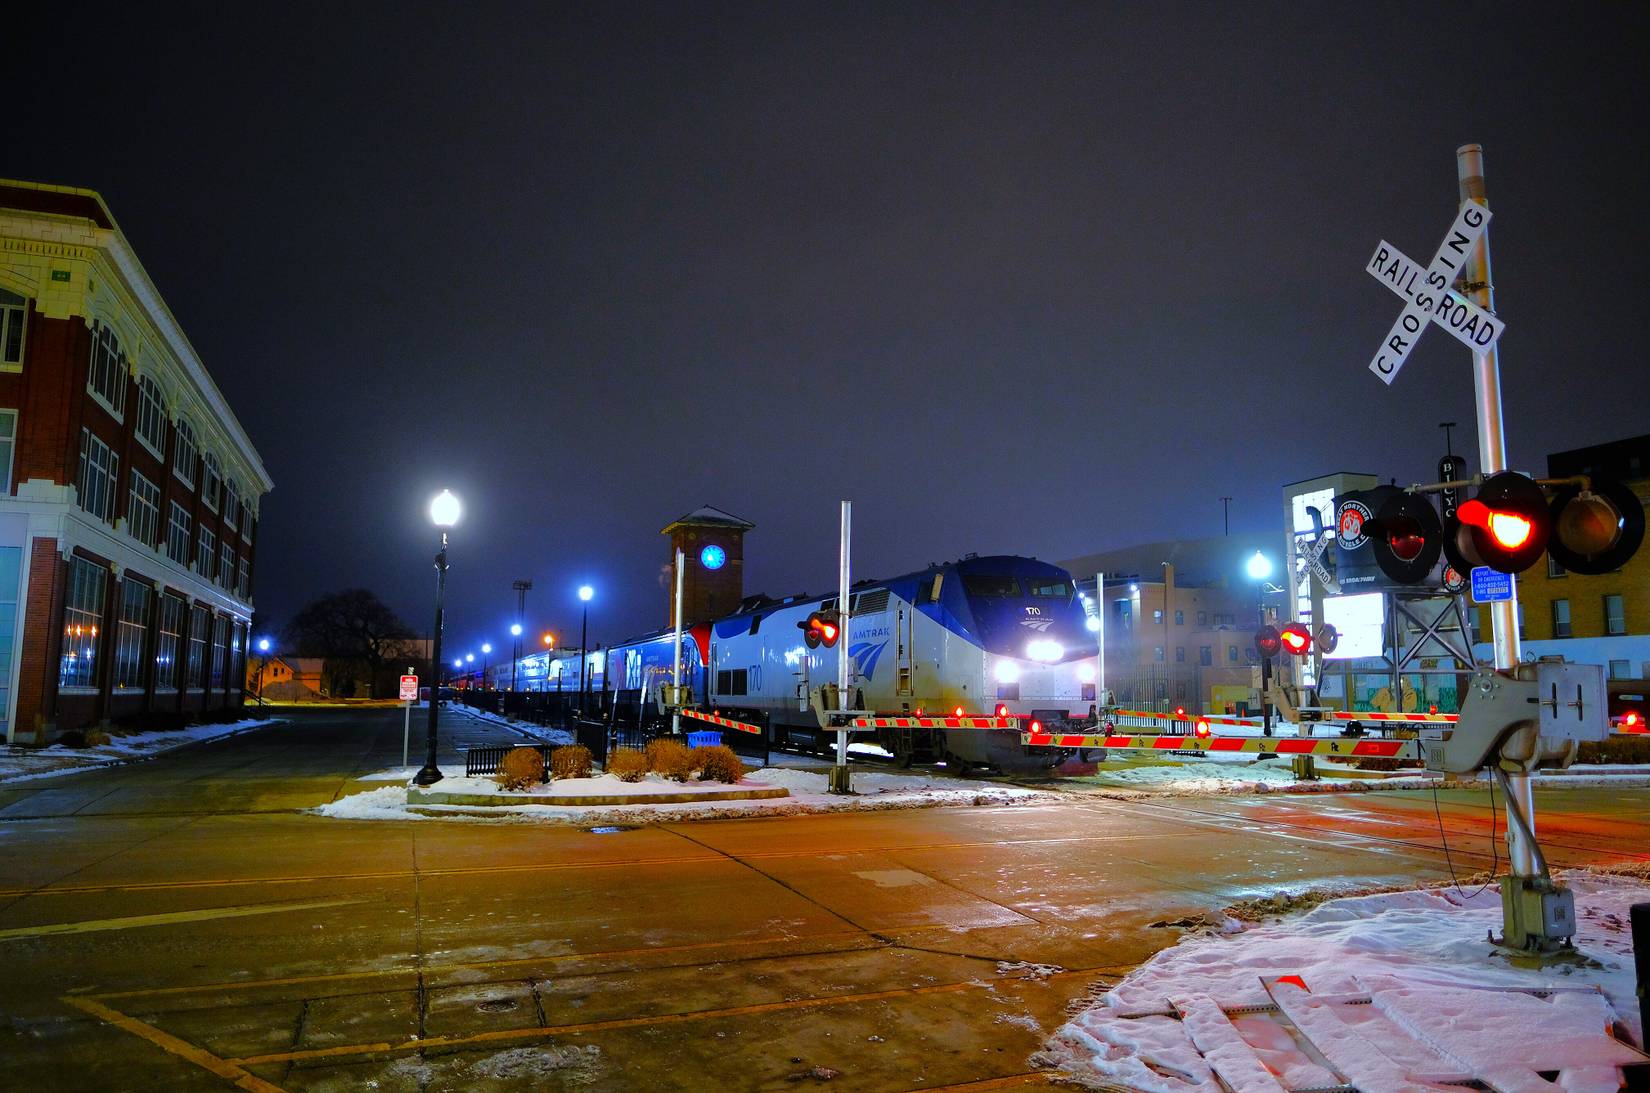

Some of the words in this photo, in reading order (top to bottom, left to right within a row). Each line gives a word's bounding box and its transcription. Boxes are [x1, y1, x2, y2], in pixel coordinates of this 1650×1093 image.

[1377, 208, 1483, 375] CROSSING
[1443, 463, 1455, 518] BICYC
[1343, 503, 1370, 522] NORTHER
[1025, 607, 1041, 616] 170
[853, 626, 890, 640] AMTRAK
[749, 663, 762, 692] 170
